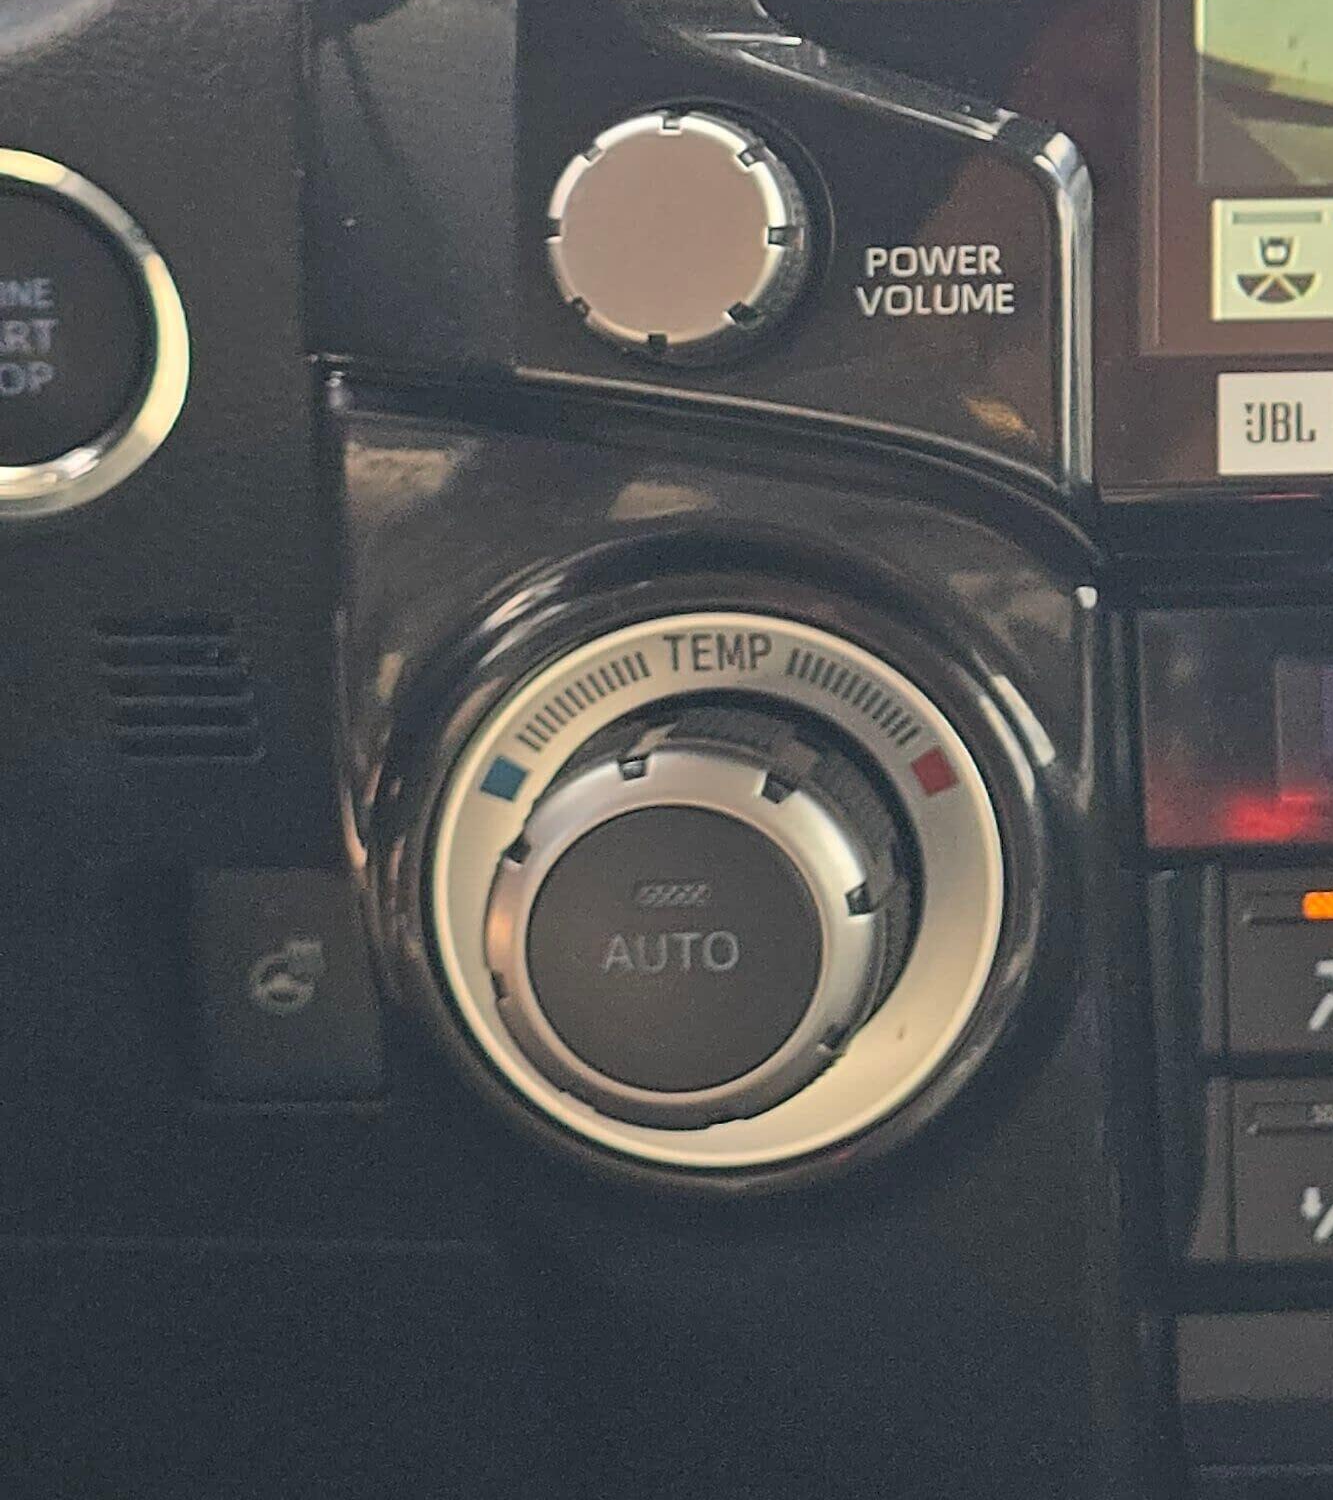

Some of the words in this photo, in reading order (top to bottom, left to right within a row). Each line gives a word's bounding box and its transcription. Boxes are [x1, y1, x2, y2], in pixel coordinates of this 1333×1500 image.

[865, 243, 1004, 279] POWER
[858, 279, 1017, 317] VOLUME
[1244, 401, 1316, 444] JBL
[663, 632, 773, 673] TEMP
[602, 930, 740, 974] AUTO
